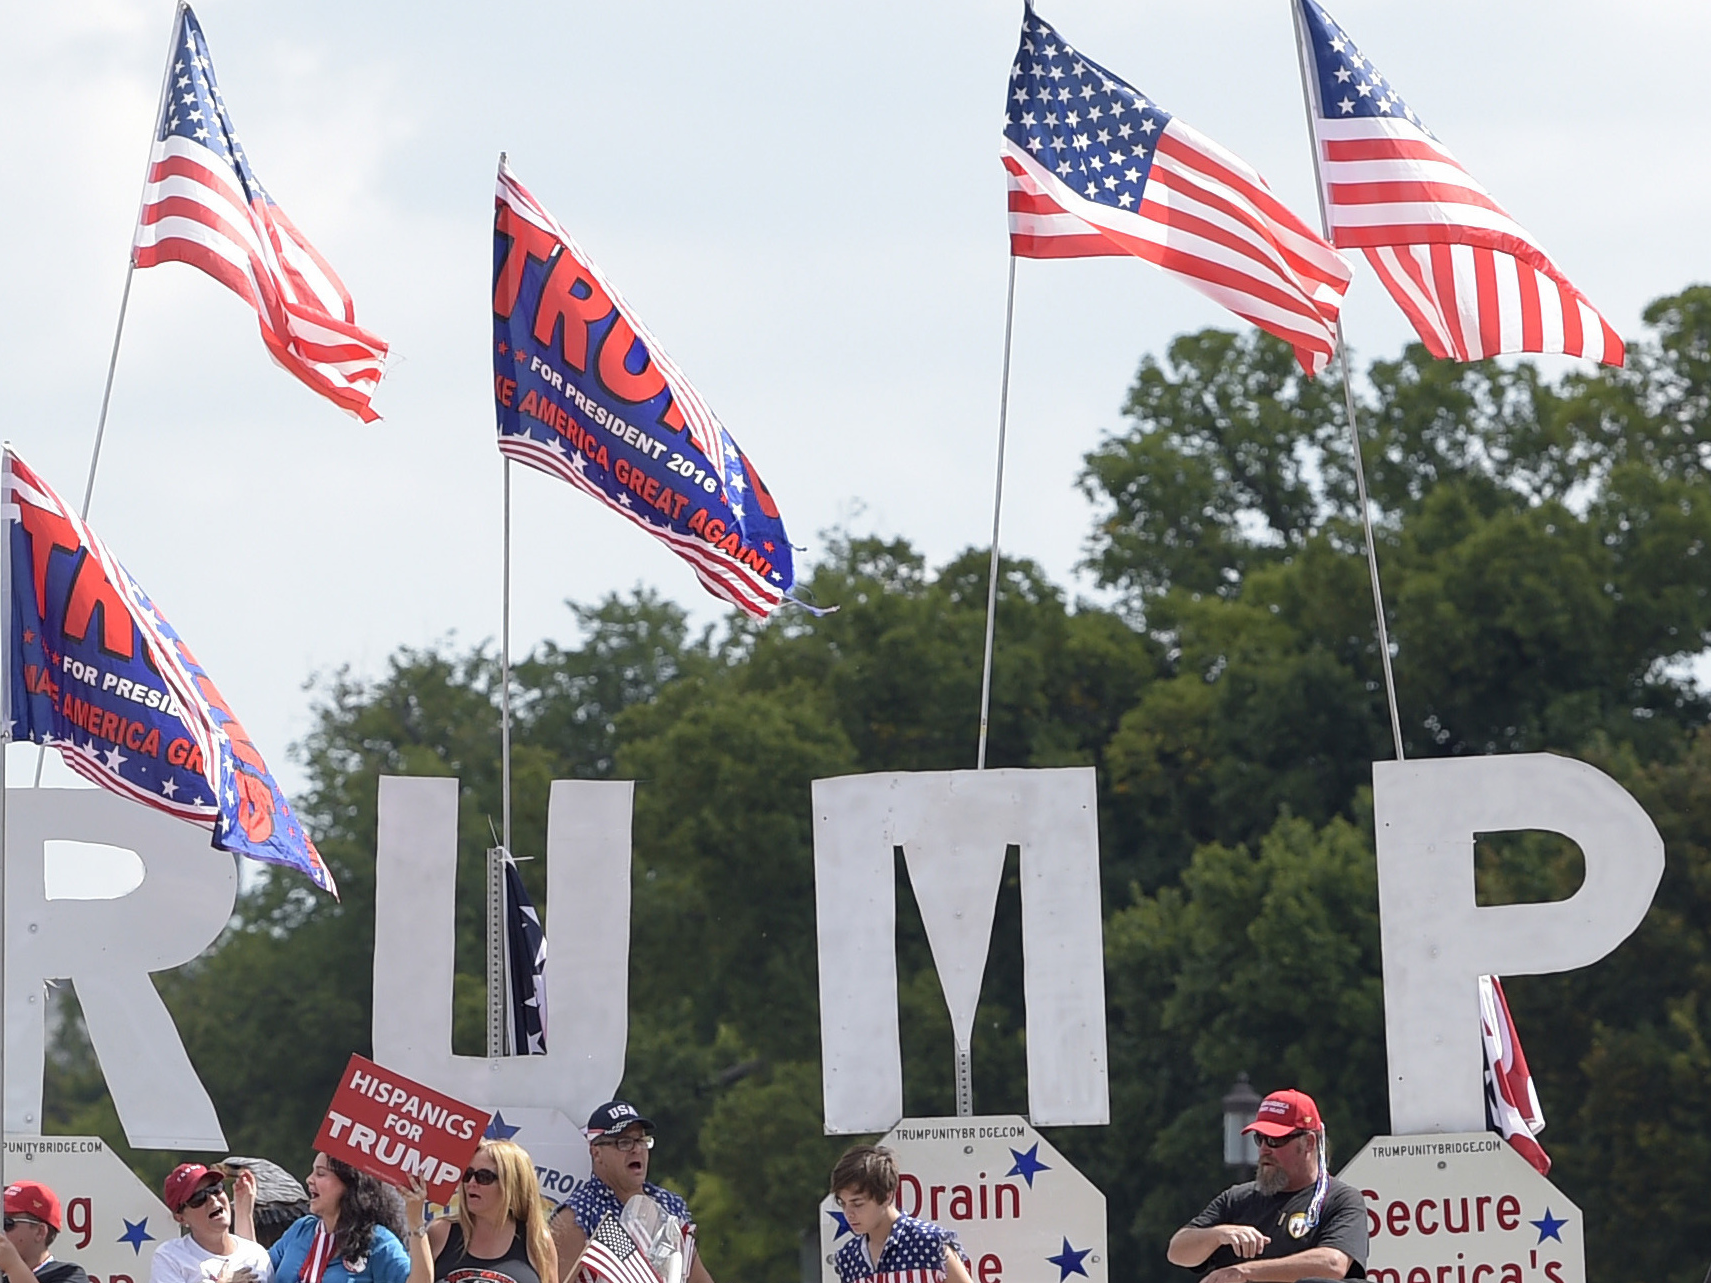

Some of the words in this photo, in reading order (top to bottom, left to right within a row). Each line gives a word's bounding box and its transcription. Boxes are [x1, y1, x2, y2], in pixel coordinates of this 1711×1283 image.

[493, 203, 695, 440] TRU
[530, 356, 563, 391] FOR
[565, 382, 668, 460] PRESIDENT
[666, 453, 717, 494] 2016
[519, 389, 610, 472] AMERICA
[614, 458, 689, 521] GREAT
[688, 508, 773, 577] AGAIN!
[62, 656, 99, 687] FOR
[62, 693, 160, 759] AMERICA
[350, 1070, 476, 1140] HISPANICS
[384, 1113, 423, 1142] FOR
[608, 1105, 638, 1119] USA
[328, 1111, 461, 1186] TRUMP
[896, 1126, 1025, 1141] TRUMPUNITYBRDGE.COM
[1372, 1141, 1501, 1158] TRUMPUNITYBRIDGE.COM
[896, 1172, 1020, 1221] Drain
[1360, 1189, 1521, 1239] Secure
